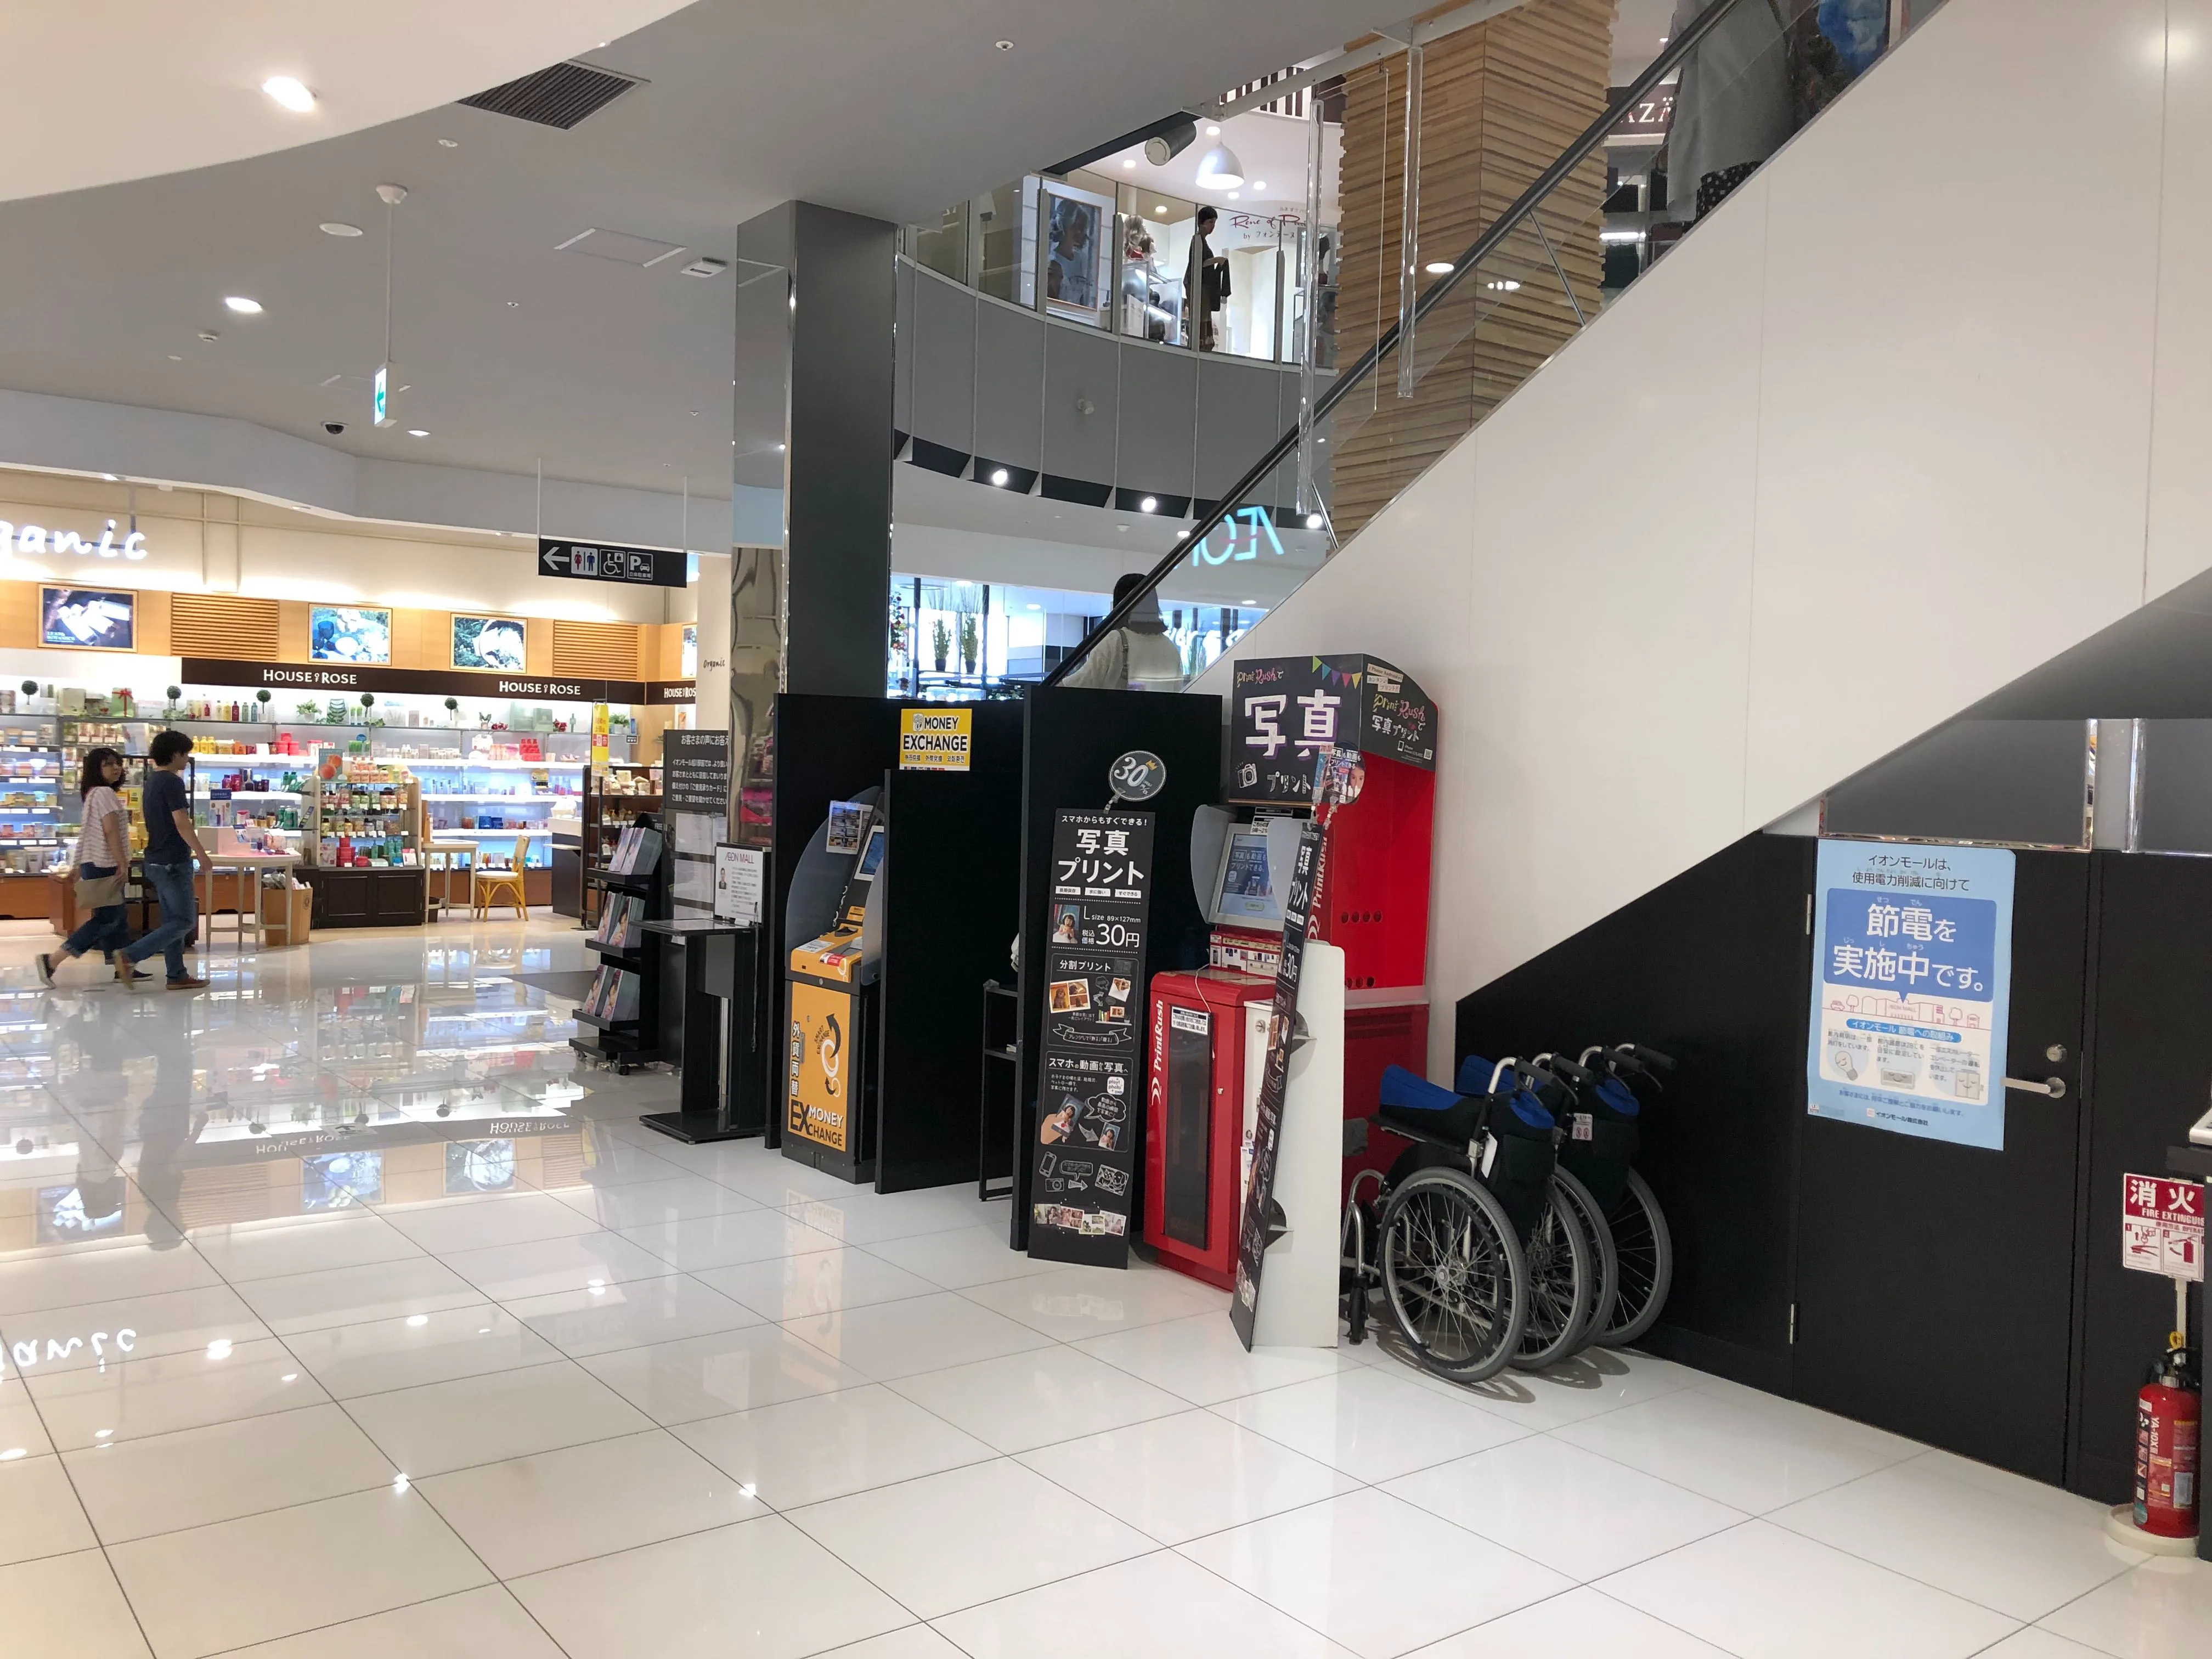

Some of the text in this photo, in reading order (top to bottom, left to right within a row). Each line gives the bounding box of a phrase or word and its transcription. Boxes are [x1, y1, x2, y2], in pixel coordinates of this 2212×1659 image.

[263, 669, 313, 682] HOUSE
[321, 672, 358, 684] ROSE
[499, 680, 542, 693] HOUSE
[550, 684, 581, 695] ROSE
[664, 687, 682, 698] HOUSE
[685, 687, 696, 698] ROS
[924, 716, 959, 730] MONEY
[1245, 689, 1341, 757] 写真
[903, 735, 968, 751] EXCHANGE
[1114, 756, 1149, 787] 30
[1267, 771, 1311, 794] プリント
[1076, 828, 1130, 856] 写真
[740, 853, 754, 864] MALL
[1868, 855, 1953, 871] イオンモールは、
[1058, 856, 1144, 885] プリント
[1852, 871, 1970, 891] 使用電力削減に向けて
[1082, 929, 1095, 937] 税込
[1866, 903, 1957, 943] 節電を
[1096, 923, 1139, 947] 30円
[1059, 959, 1111, 972] 分割プリント
[1833, 944, 1983, 992] 実施中です。
[1153, 999, 1164, 1073] PrintRush
[1852, 1021, 1897, 1033] イオンモール
[808, 1104, 844, 1128] MONEY
[2129, 1179, 2196, 1214] 消火
[2142, 1207, 2160, 1218] FIRE
